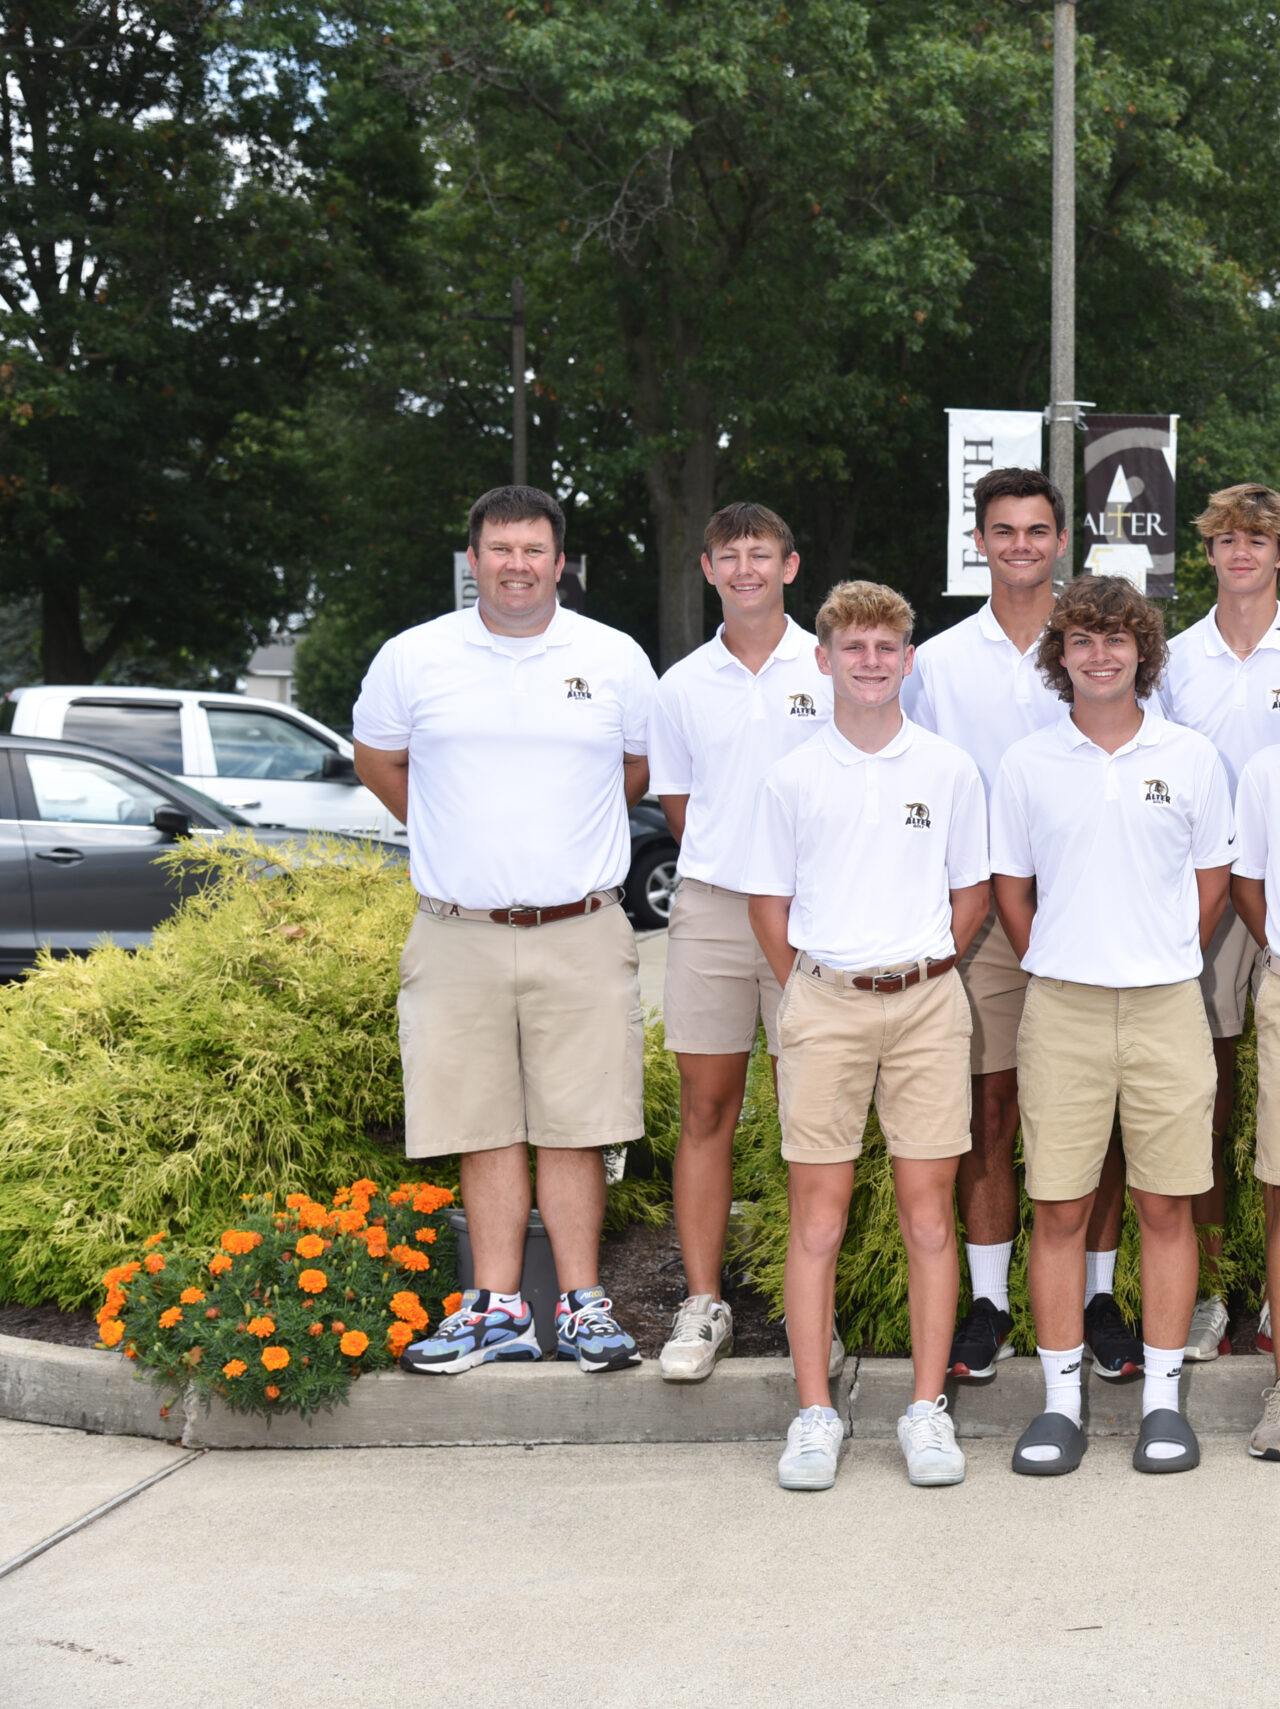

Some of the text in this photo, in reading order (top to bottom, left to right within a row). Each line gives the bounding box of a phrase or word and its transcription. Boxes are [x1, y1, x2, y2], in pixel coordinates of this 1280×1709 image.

[1082, 503, 1168, 539] ALTER
[567, 691, 592, 700] ALTER
[790, 707, 816, 717] ALTER
[1145, 793, 1171, 804] ALTER
[905, 816, 931, 828] ALTER
[449, 904, 460, 916] A
[812, 965, 822, 978] A
